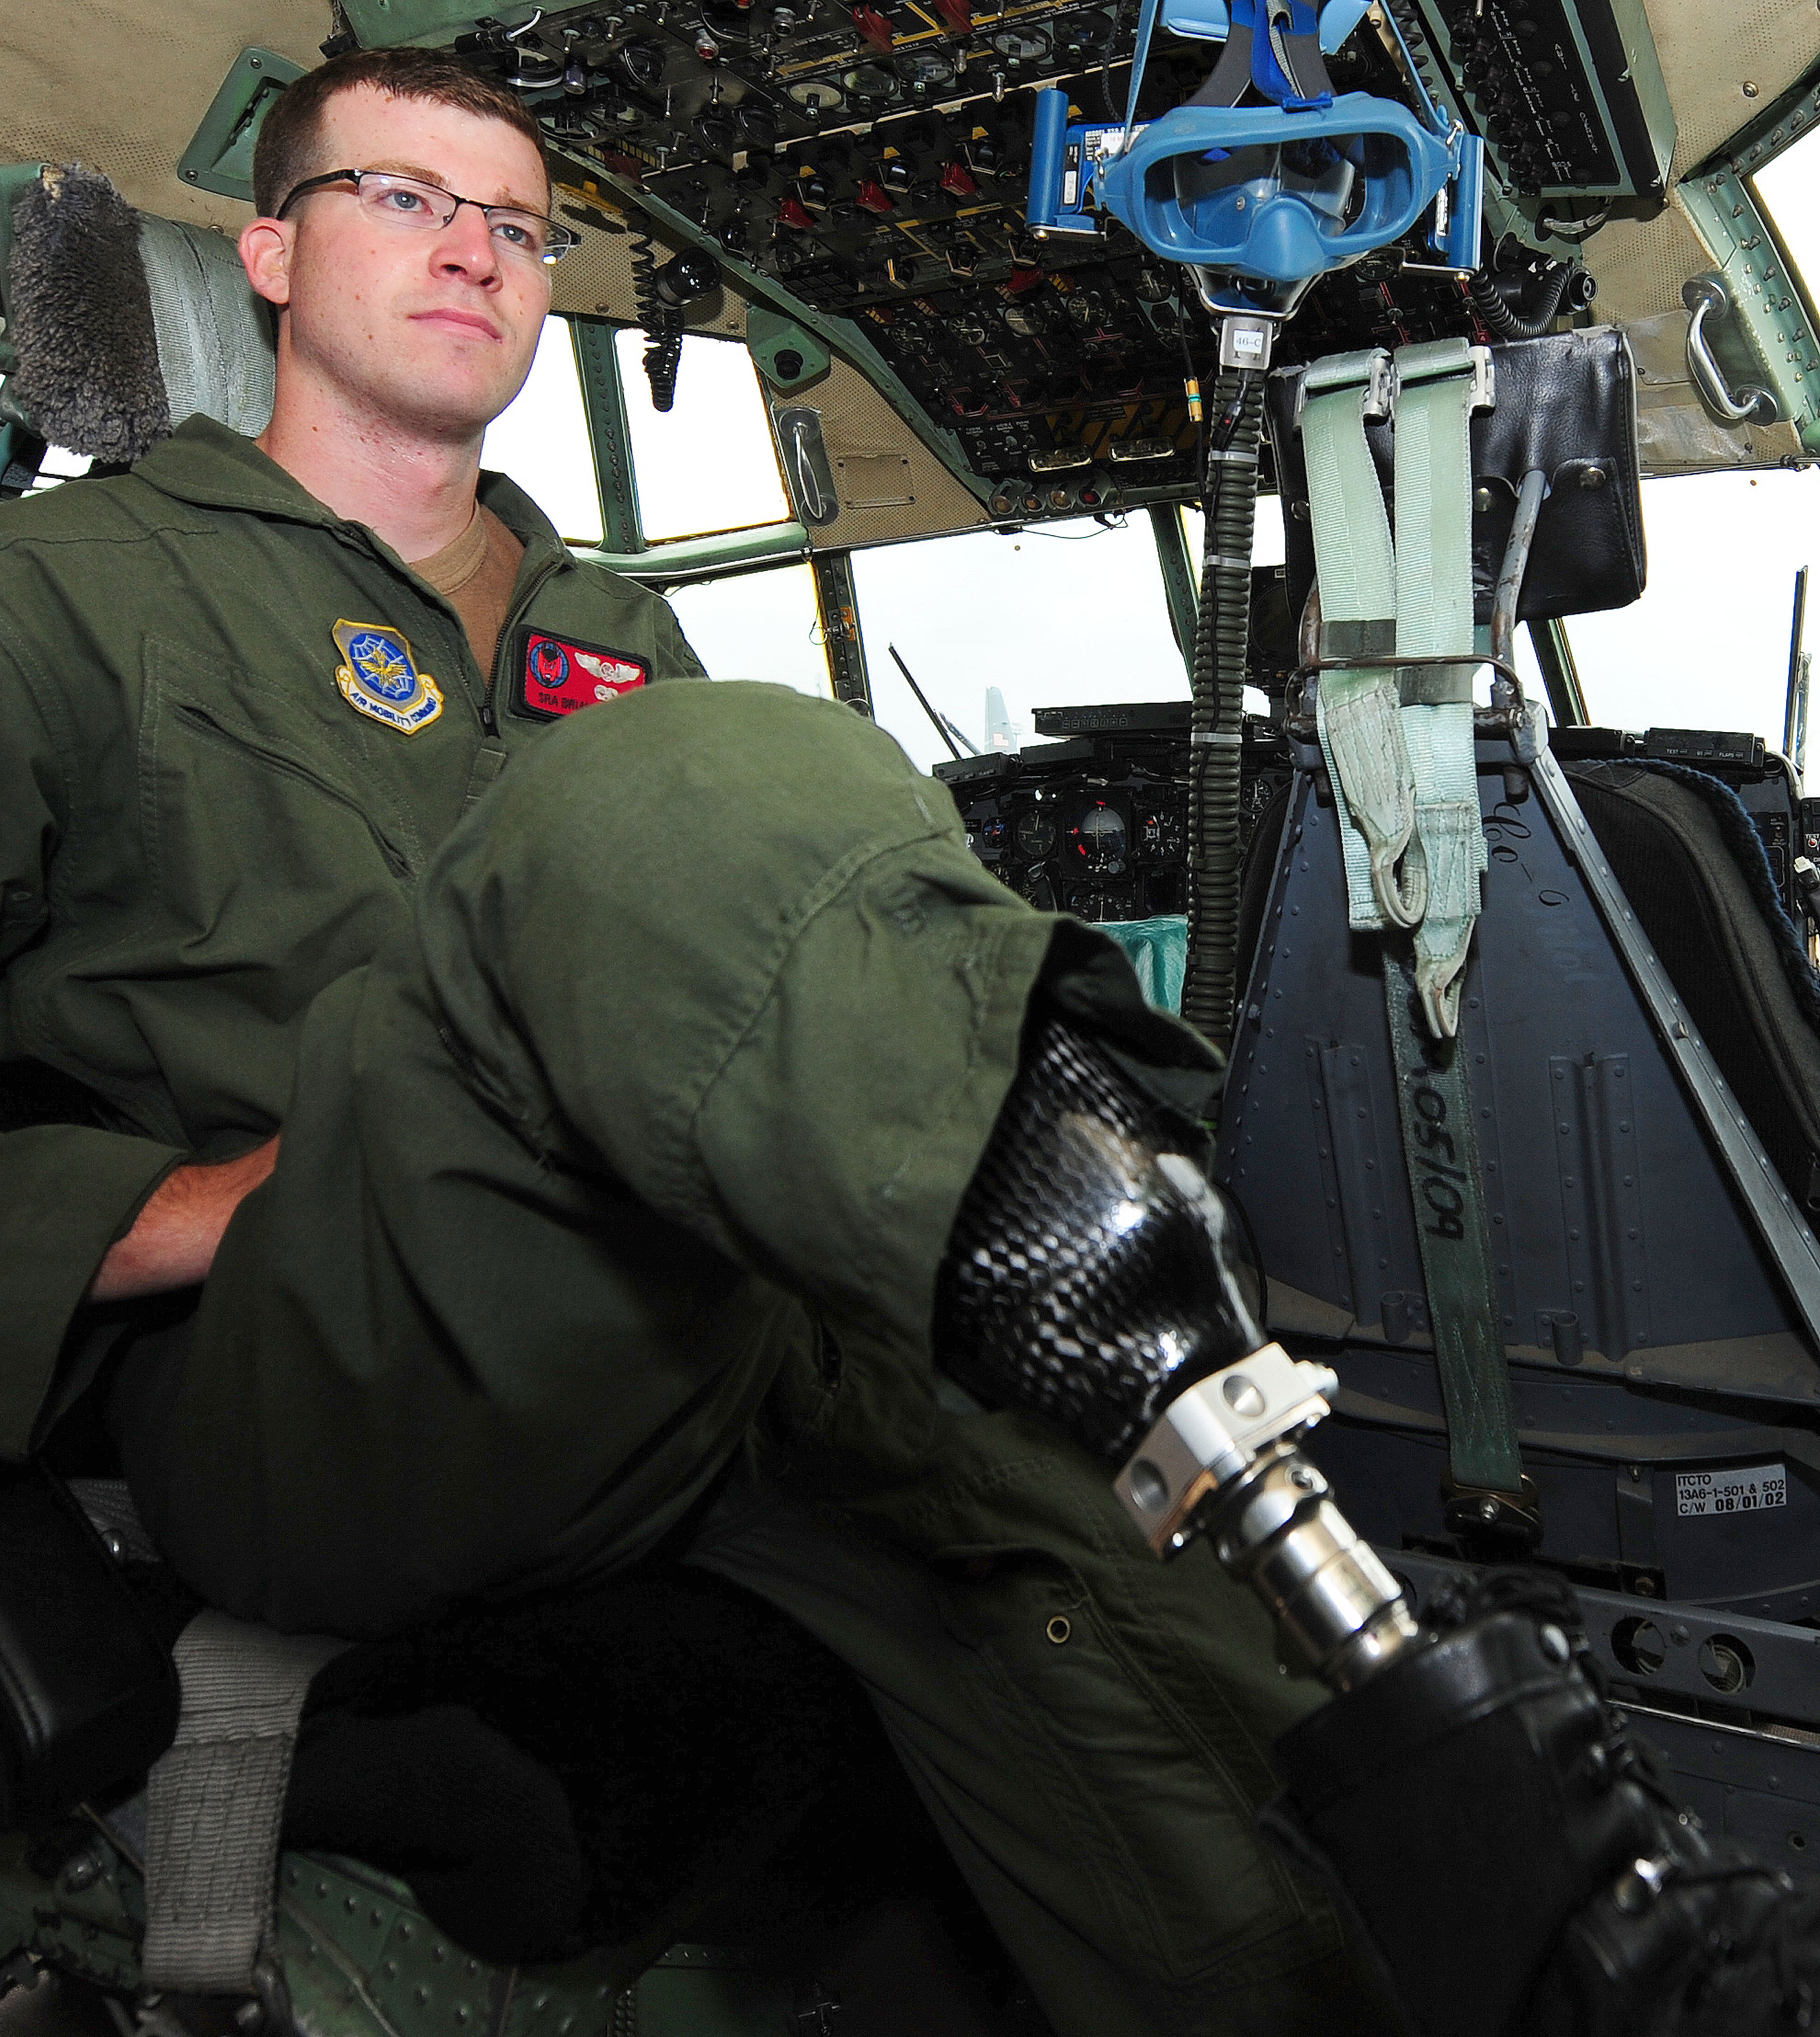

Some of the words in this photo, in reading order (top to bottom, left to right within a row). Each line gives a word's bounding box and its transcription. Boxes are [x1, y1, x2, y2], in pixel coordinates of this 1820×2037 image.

[350, 692, 367, 707] AIR
[1677, 1474, 1711, 1486] ITCTO
[1678, 1485, 1744, 1501] 13A6-1-501
[1748, 1483, 1757, 1494] &
[1762, 1479, 1785, 1492] 502
[1679, 1502, 1706, 1514] C/W
[1715, 1491, 1784, 1512] 08/01/02
